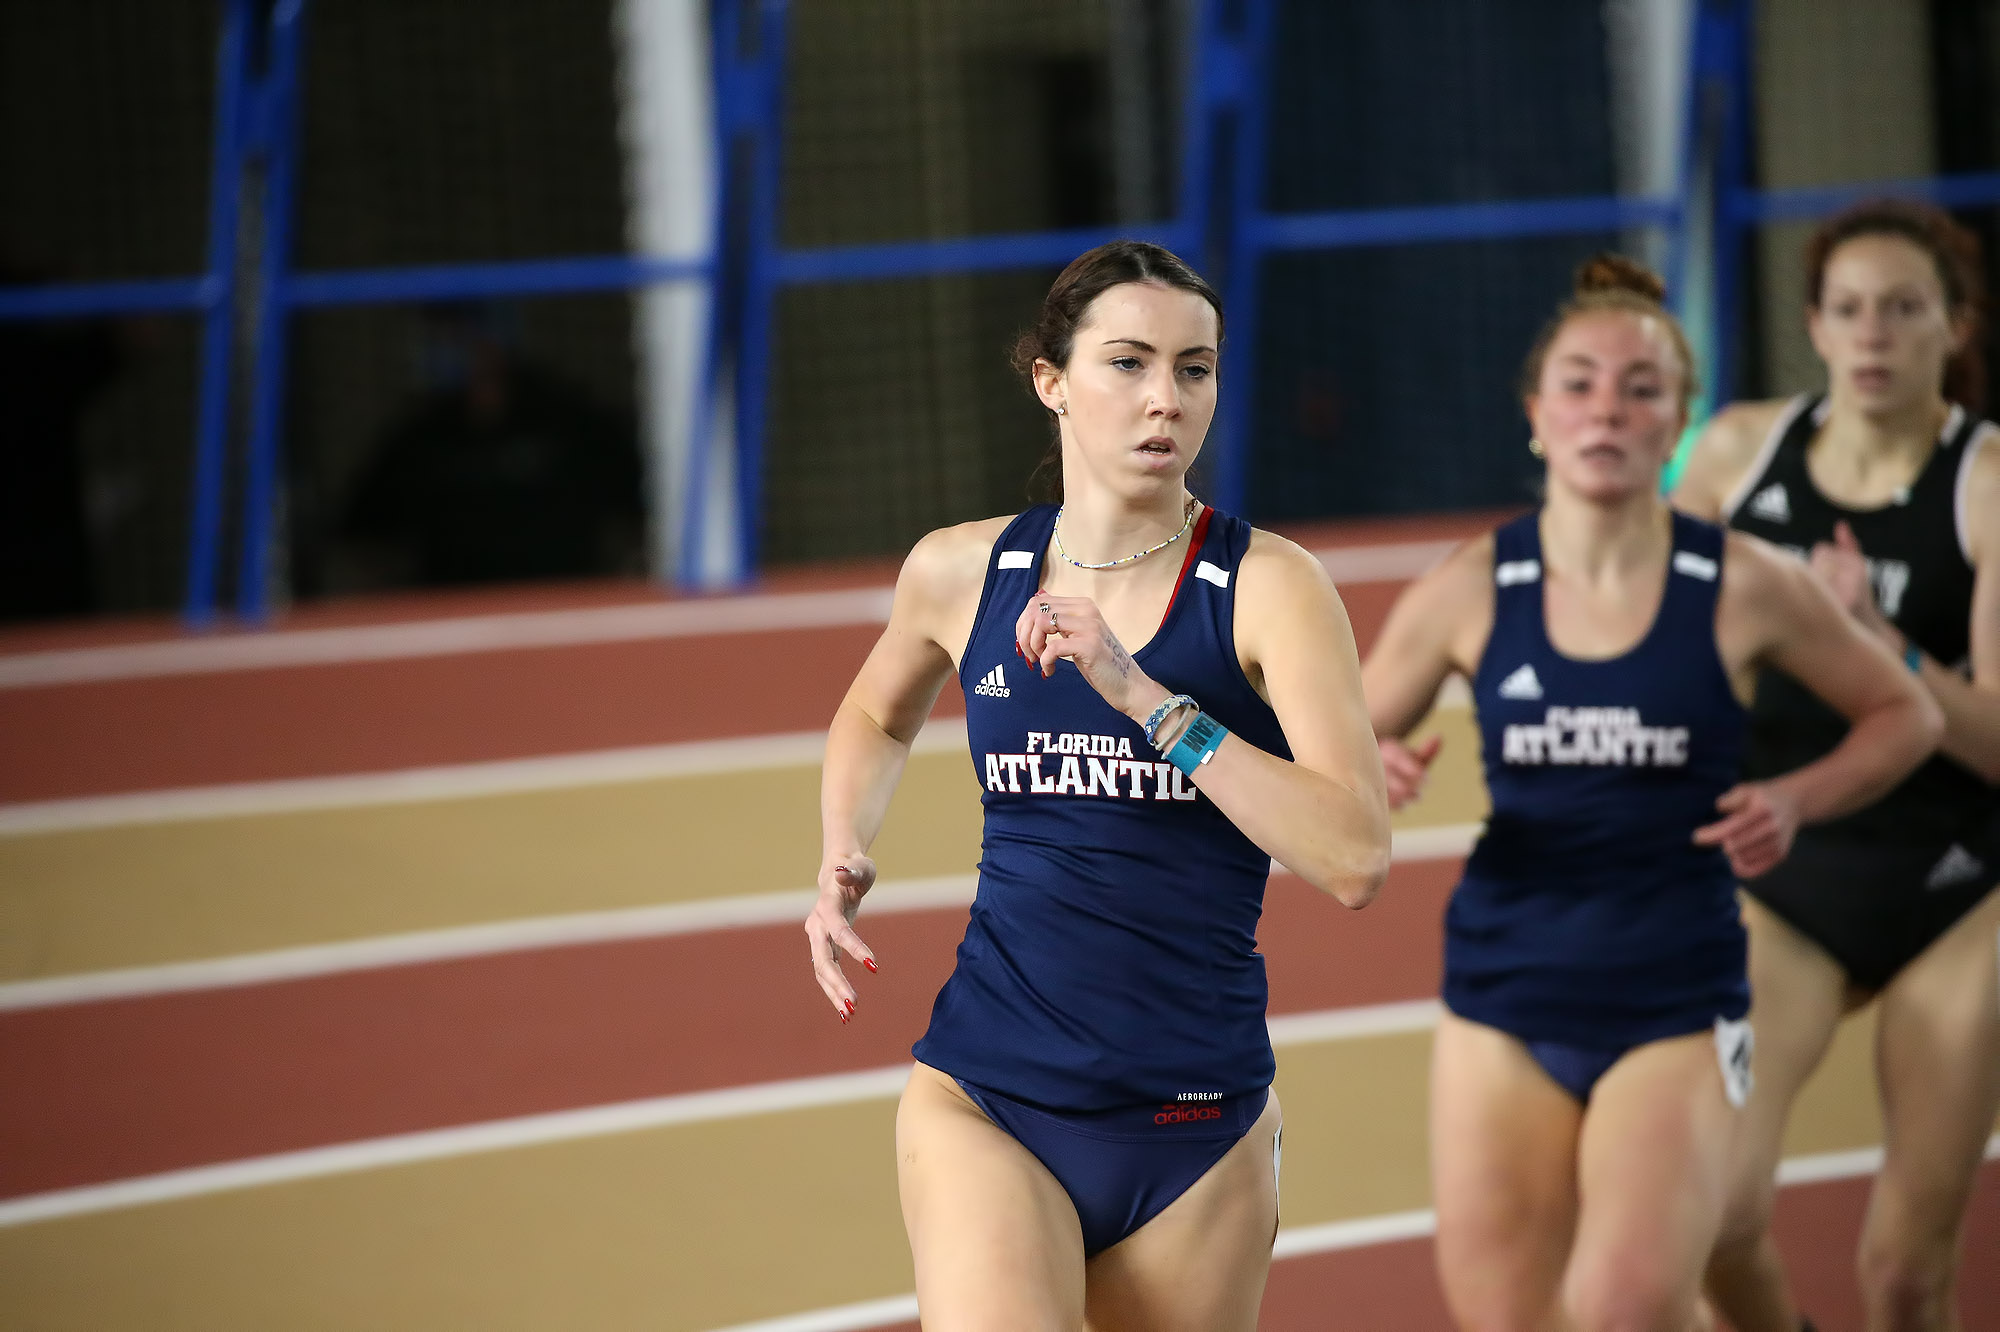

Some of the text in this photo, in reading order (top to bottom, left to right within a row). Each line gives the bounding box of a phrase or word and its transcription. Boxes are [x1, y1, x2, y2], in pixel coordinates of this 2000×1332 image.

[974, 683, 1011, 698] adidas
[1026, 731, 1134, 759] FLORIDA
[985, 752, 1197, 801] ATLANTIC
[1177, 1092, 1223, 1101] AEROREADY
[1154, 1106, 1221, 1124] adidas
